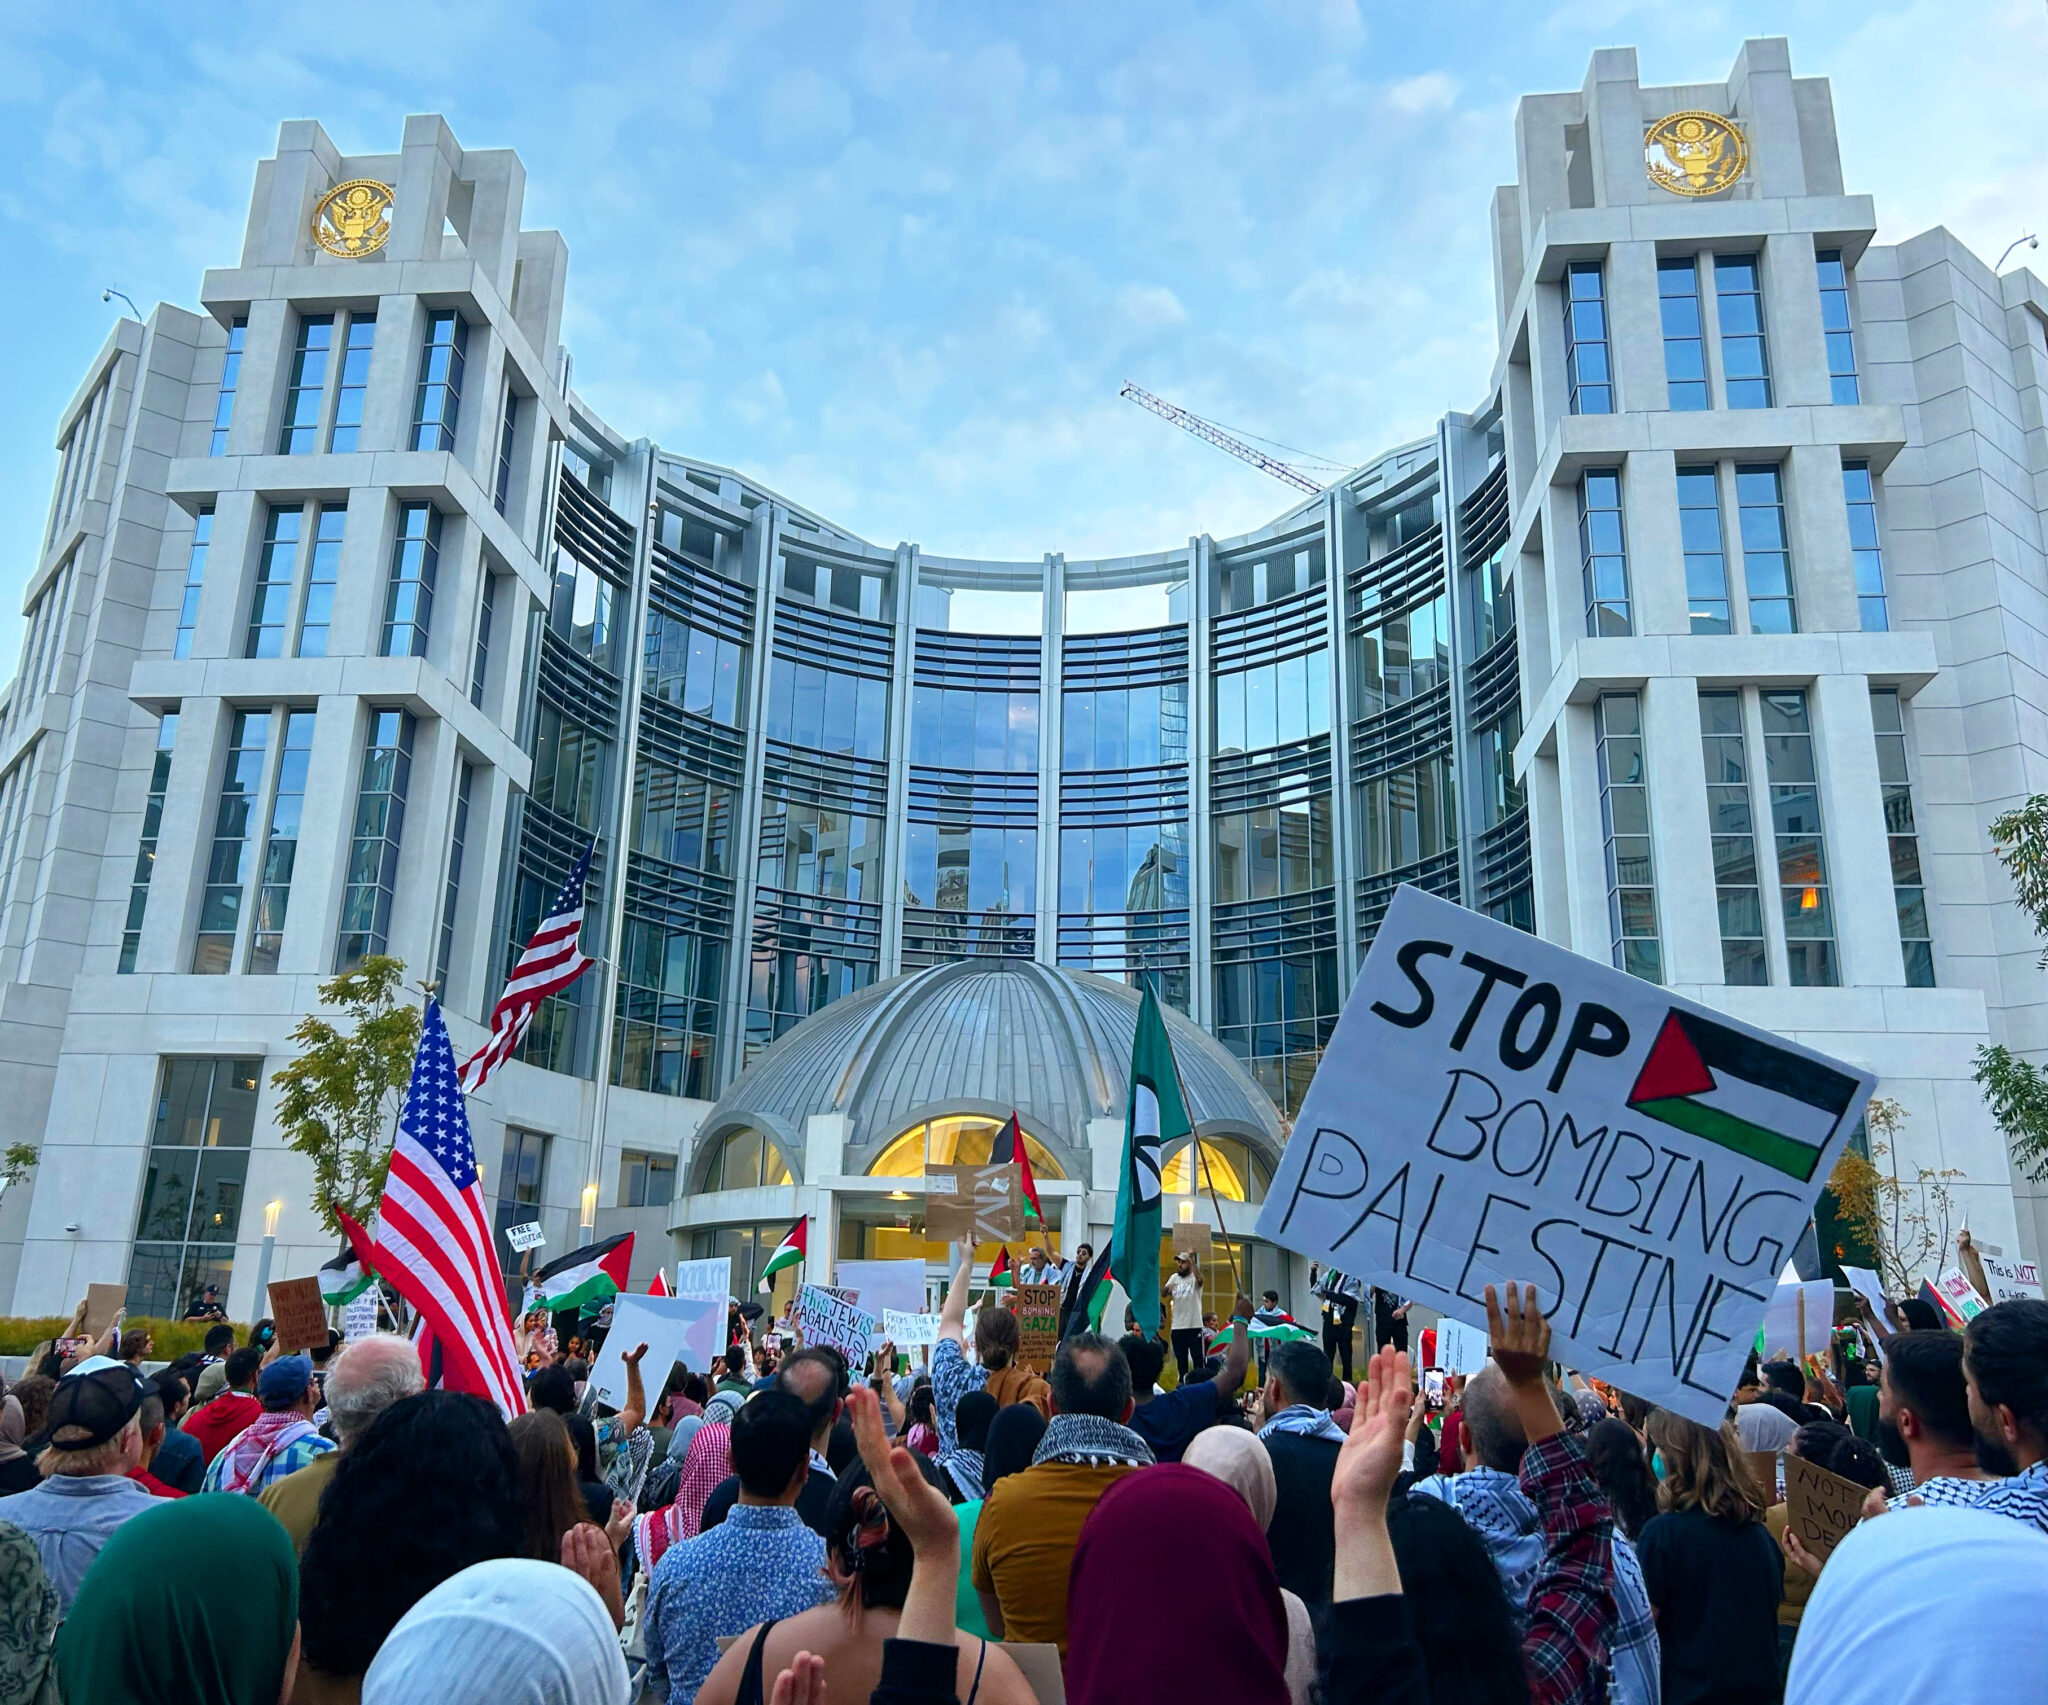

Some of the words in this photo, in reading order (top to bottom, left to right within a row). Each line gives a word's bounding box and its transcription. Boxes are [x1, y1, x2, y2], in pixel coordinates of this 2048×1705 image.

[1370, 940, 1630, 1093] STOP
[1425, 1068, 1802, 1275] BOMBING
[511, 1224, 531, 1236] FREE
[1280, 1128, 1768, 1402] PALESTINE
[1984, 1258, 2004, 1277] This
[2005, 1266, 2014, 1278] is
[2014, 1264, 2036, 1283] NOT
[803, 1286, 829, 1317] this
[829, 1298, 861, 1328] JEW
[1024, 1288, 1056, 1306] STOP
[886, 1310, 908, 1325] FROM
[911, 1315, 928, 1325] THE
[1021, 1316, 1057, 1332] GAZA
[1022, 1307, 1056, 1317] BOMBING
[799, 1305, 857, 1346] AGAINST
[904, 1327, 917, 1340] TO
[1798, 1467, 1855, 1504] NOT
